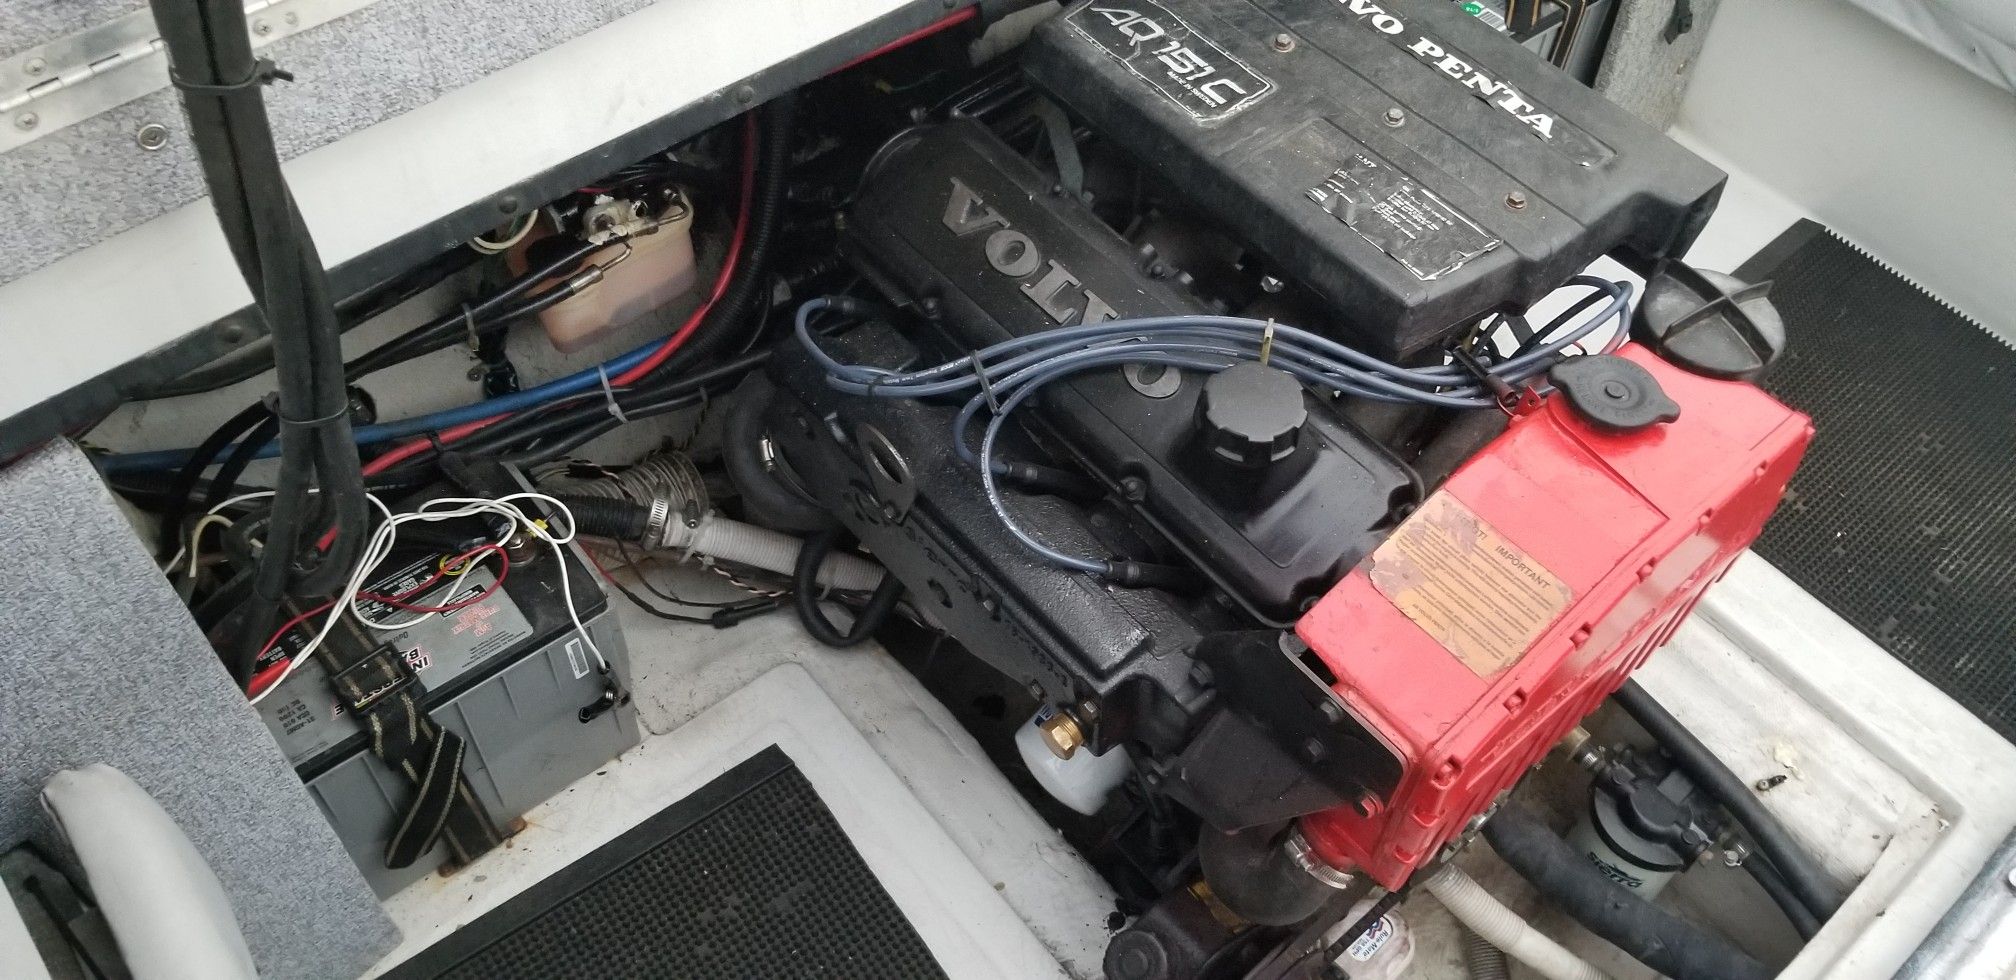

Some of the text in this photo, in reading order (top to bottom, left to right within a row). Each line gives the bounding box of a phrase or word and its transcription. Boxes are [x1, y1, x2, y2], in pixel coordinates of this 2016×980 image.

[1090, 7, 1247, 105] AQ 151 C
[1406, 36, 1553, 139] PENTA
[1495, 545, 1551, 589] IMPORTANT
